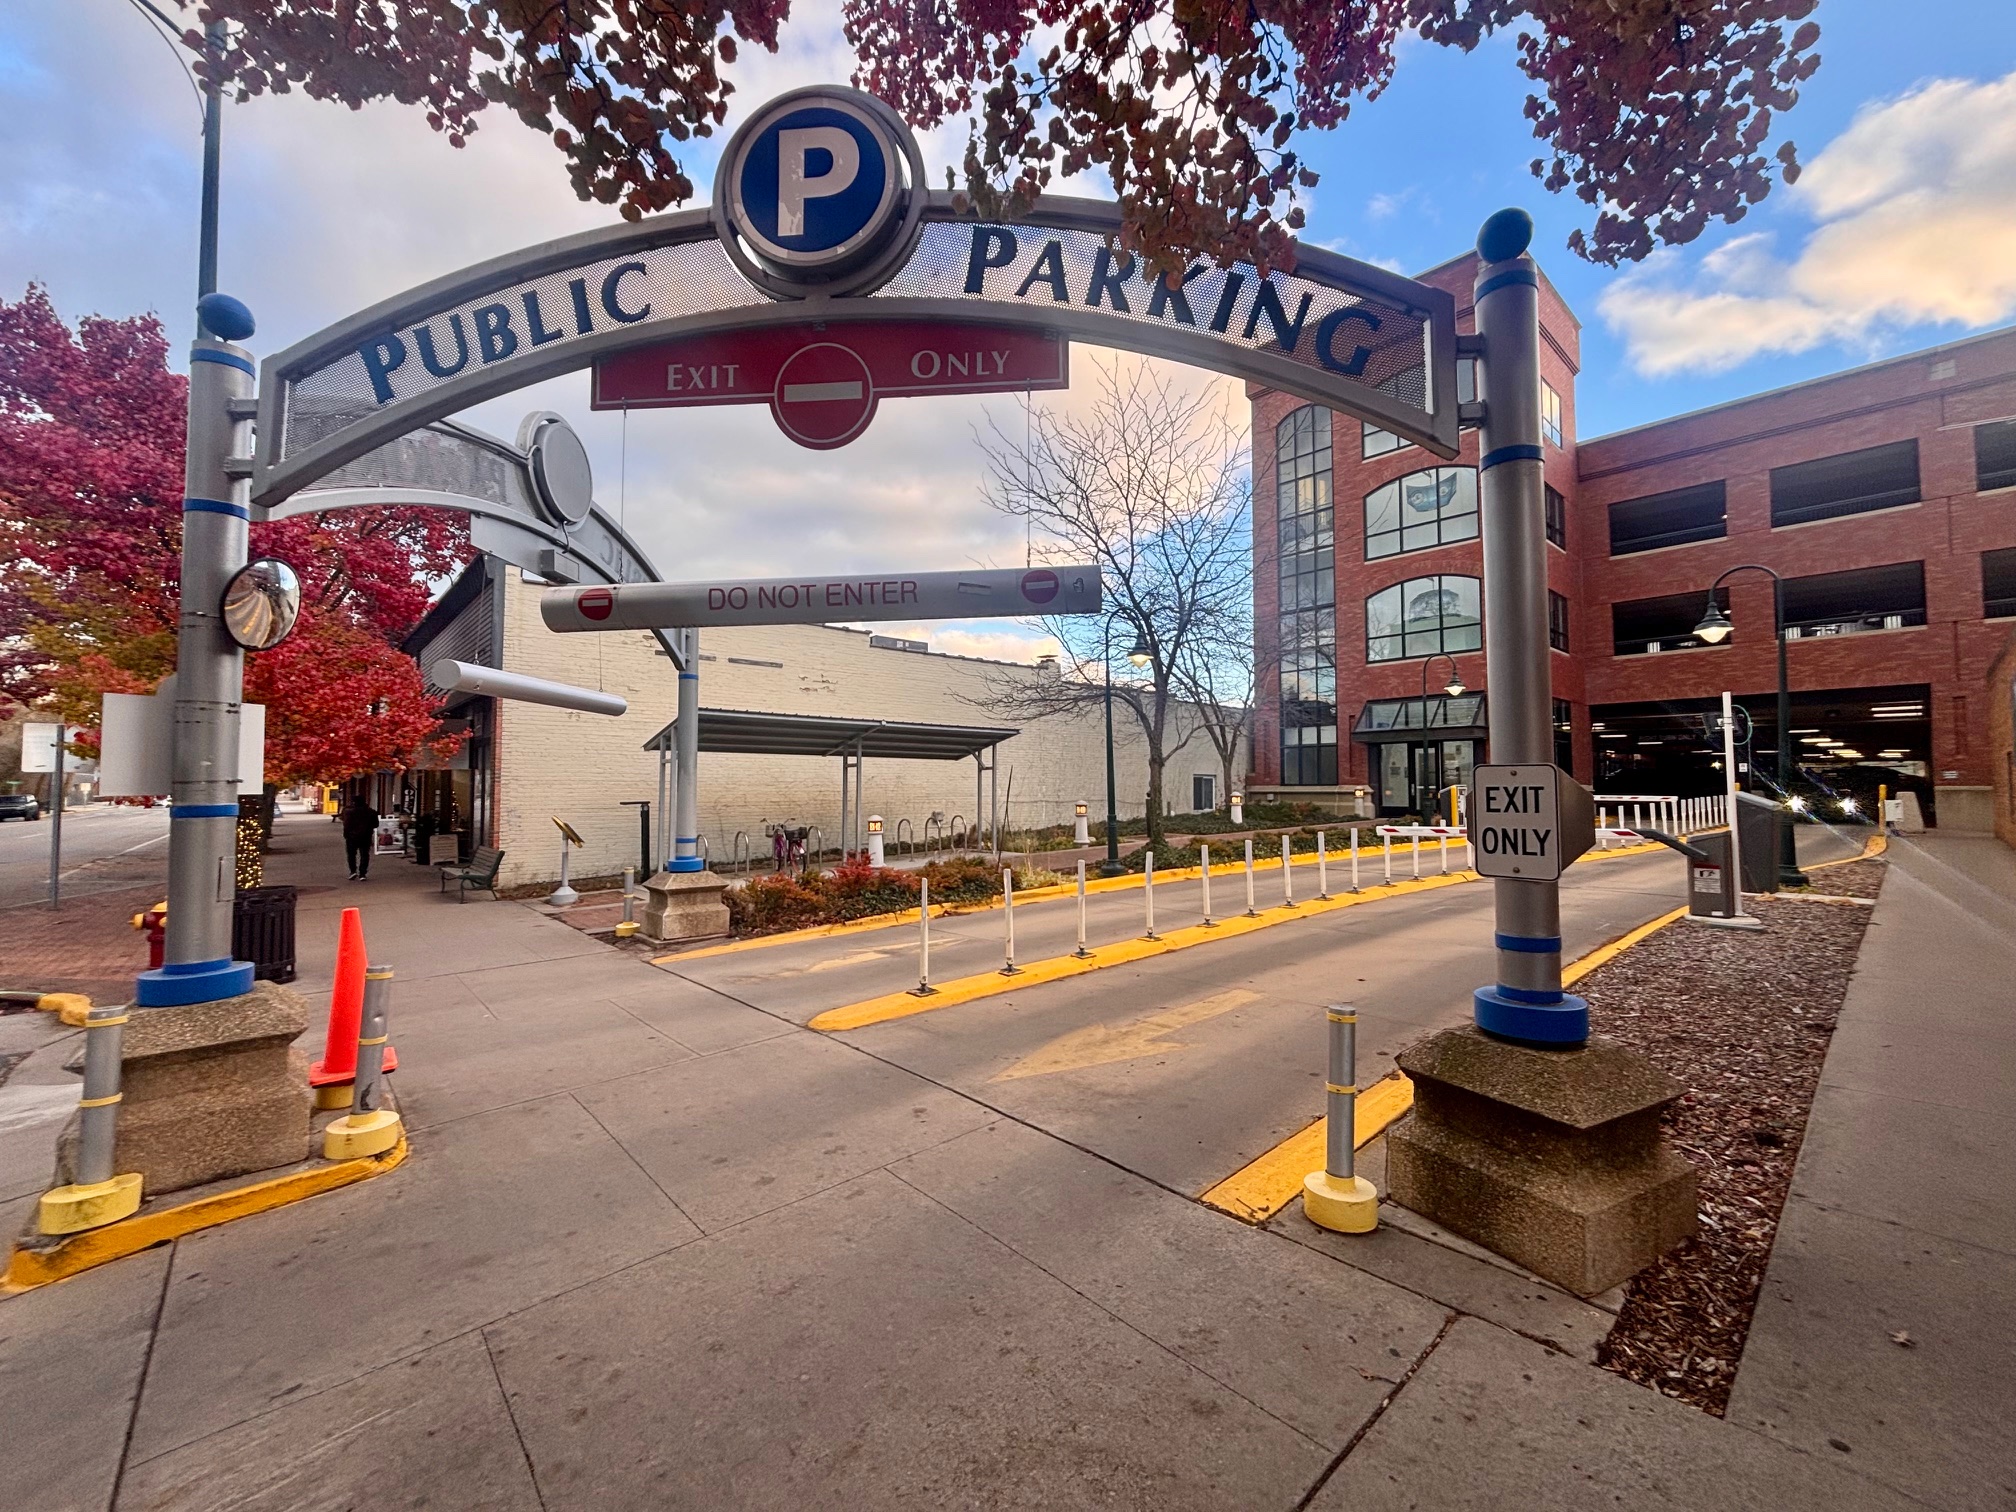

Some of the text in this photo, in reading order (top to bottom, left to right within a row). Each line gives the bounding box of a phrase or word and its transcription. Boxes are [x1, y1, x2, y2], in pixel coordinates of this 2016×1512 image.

[777, 126, 861, 237] P
[357, 224, 1382, 404] PUBLIC PARKING
[666, 349, 1012, 392] EXIT ONLY
[707, 580, 918, 611] DO NOT ENTER
[1485, 786, 1545, 814] EXIT
[1482, 827, 1551, 857] ONLY
